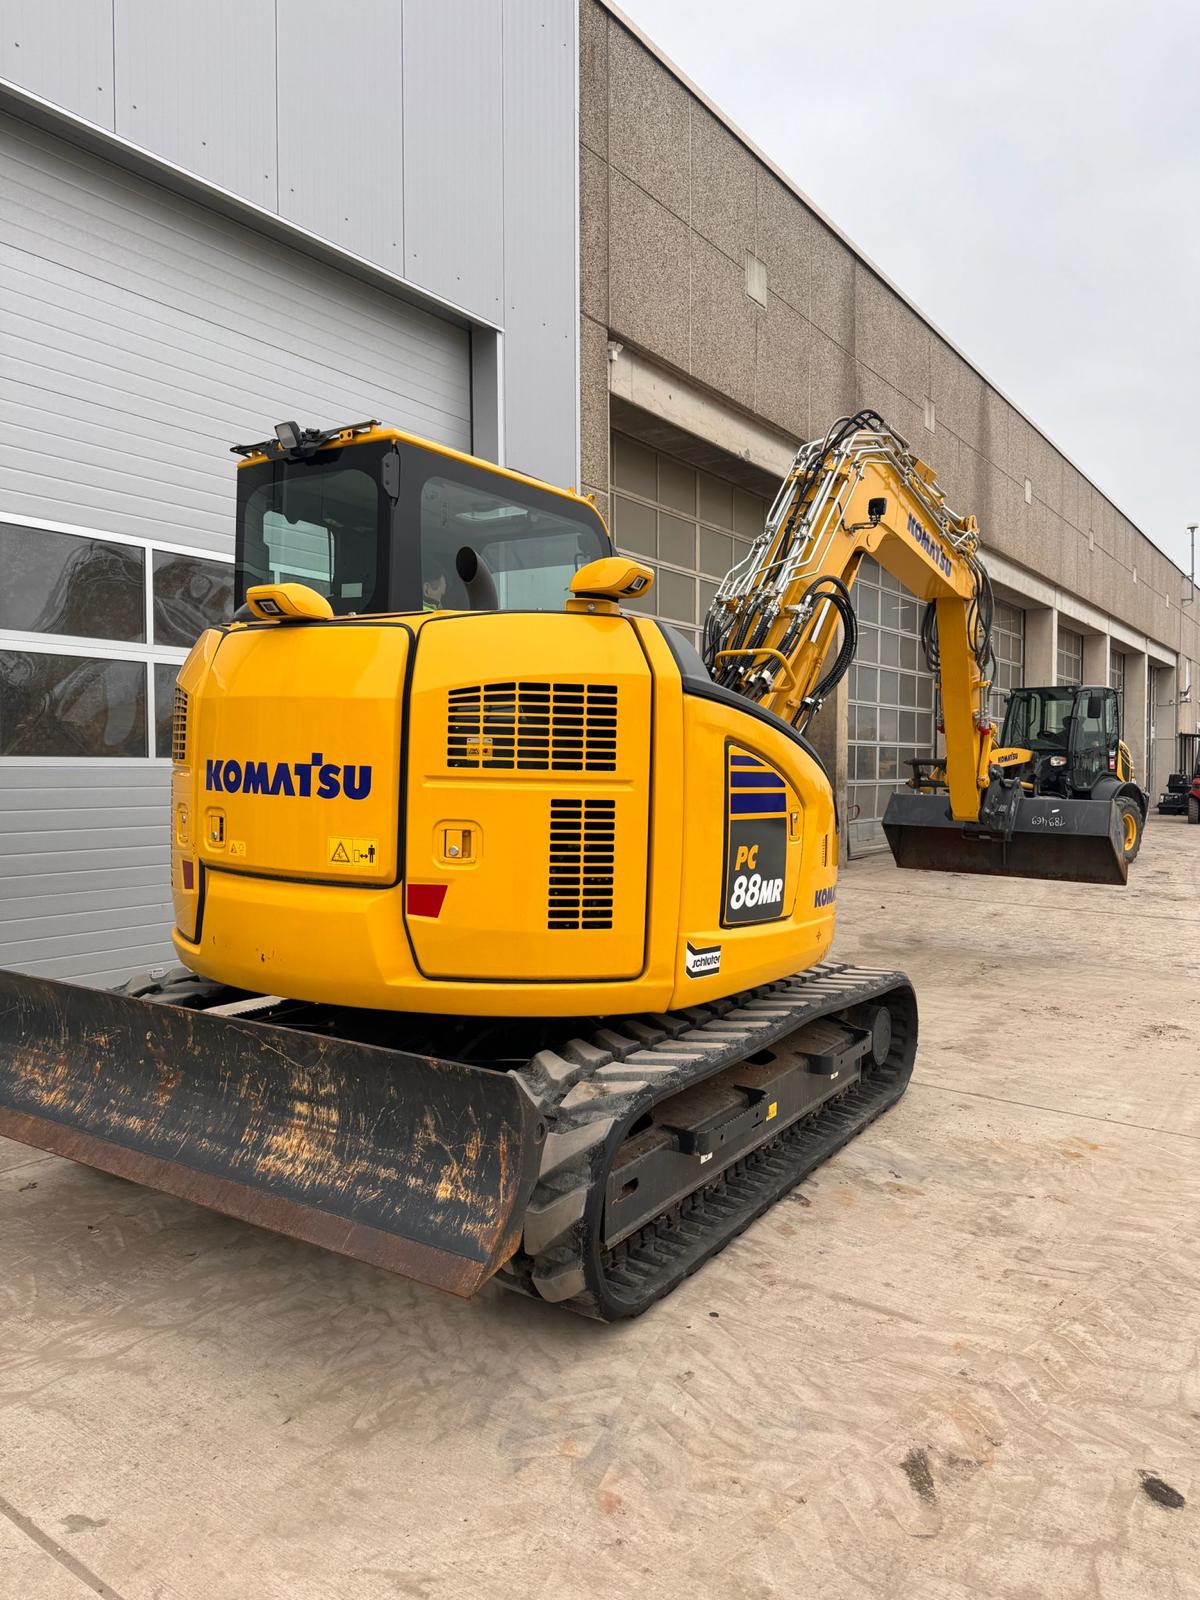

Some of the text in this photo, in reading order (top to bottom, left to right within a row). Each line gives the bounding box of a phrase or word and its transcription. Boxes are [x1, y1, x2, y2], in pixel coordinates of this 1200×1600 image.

[907, 511, 952, 577] KOMATSU
[206, 752, 372, 800] KOMATSU
[998, 752, 1018, 763] KOMATSU
[735, 844, 759, 872] PC
[730, 873, 783, 910] 88MR
